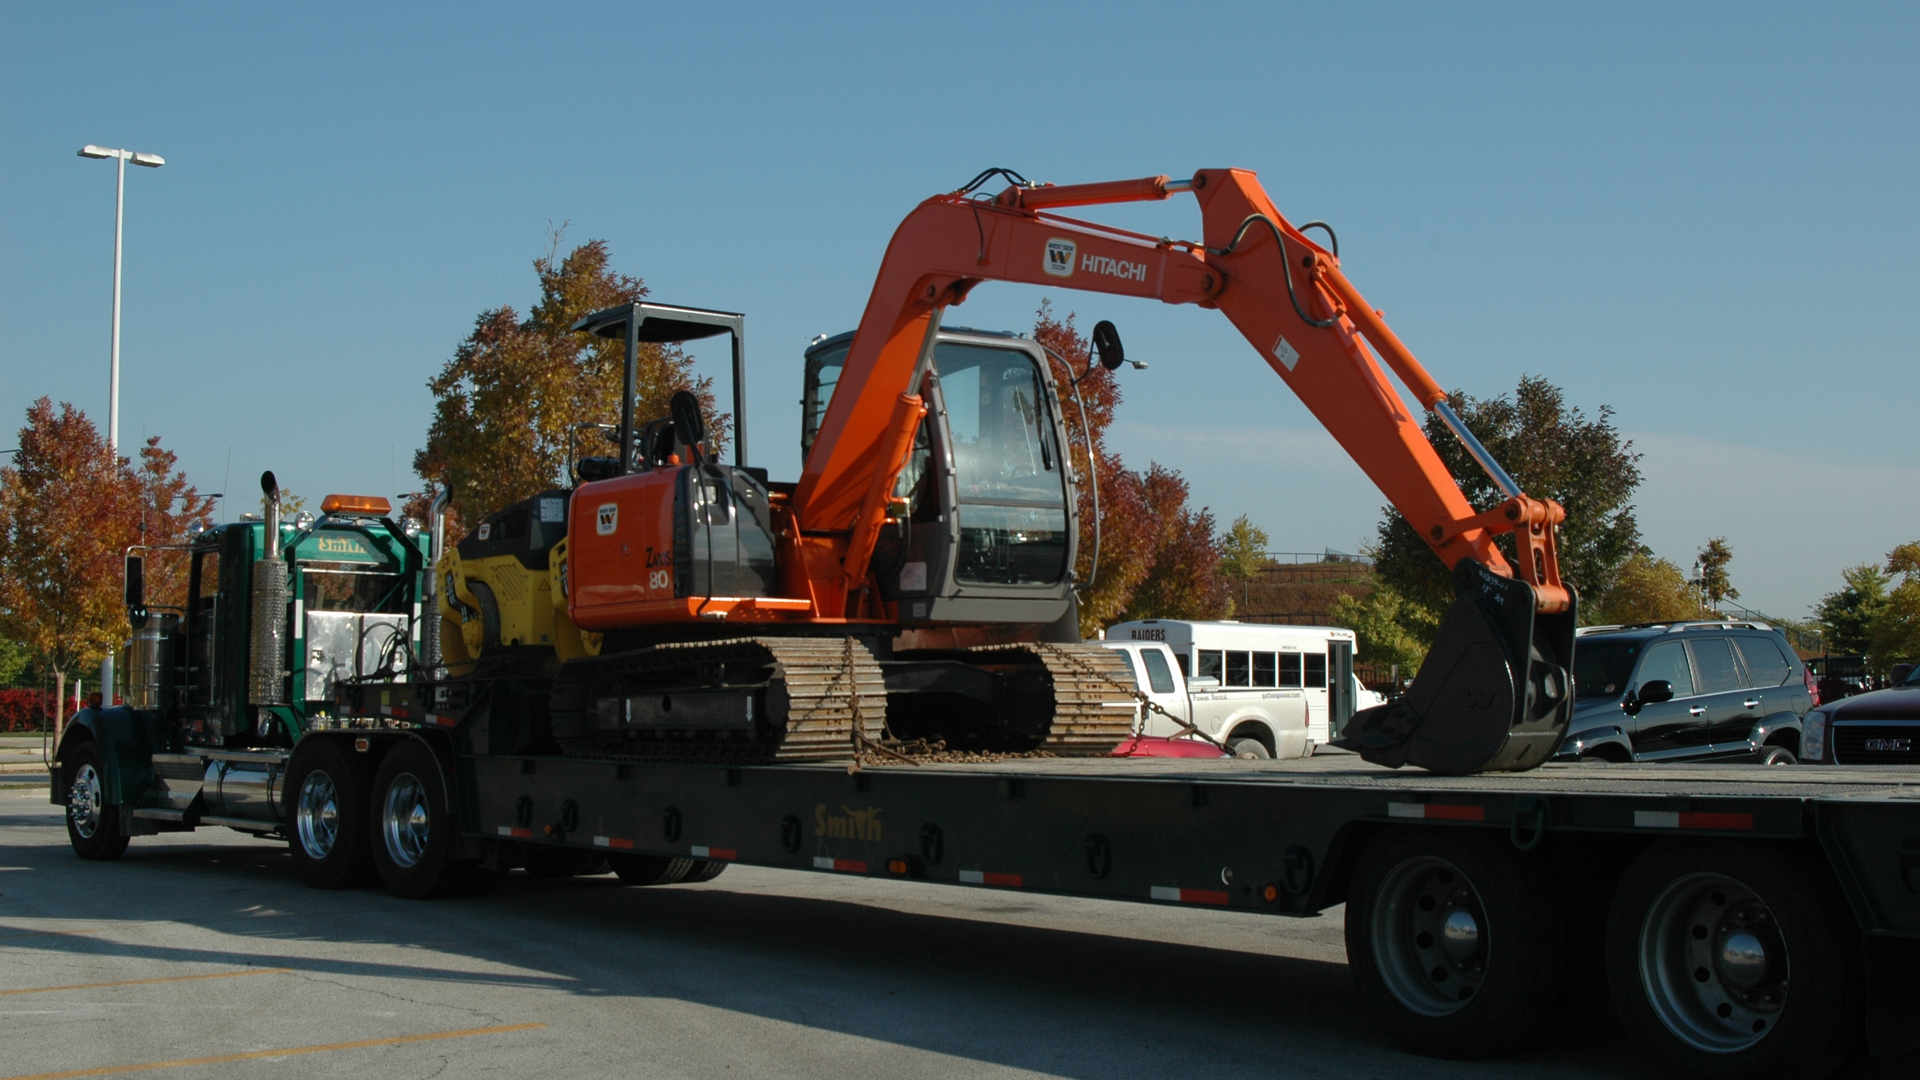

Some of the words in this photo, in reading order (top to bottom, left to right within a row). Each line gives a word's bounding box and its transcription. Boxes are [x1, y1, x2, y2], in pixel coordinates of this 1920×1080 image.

[1048, 242, 1062, 250] WEST
[1062, 244, 1075, 252] SIDE
[1049, 249, 1072, 265] W
[1081, 253, 1147, 282] HITACHI
[649, 570, 669, 589] 80
[1131, 629, 1166, 642] RAIDERS
[1865, 739, 1911, 751] GMC
[814, 803, 883, 841] Smith
